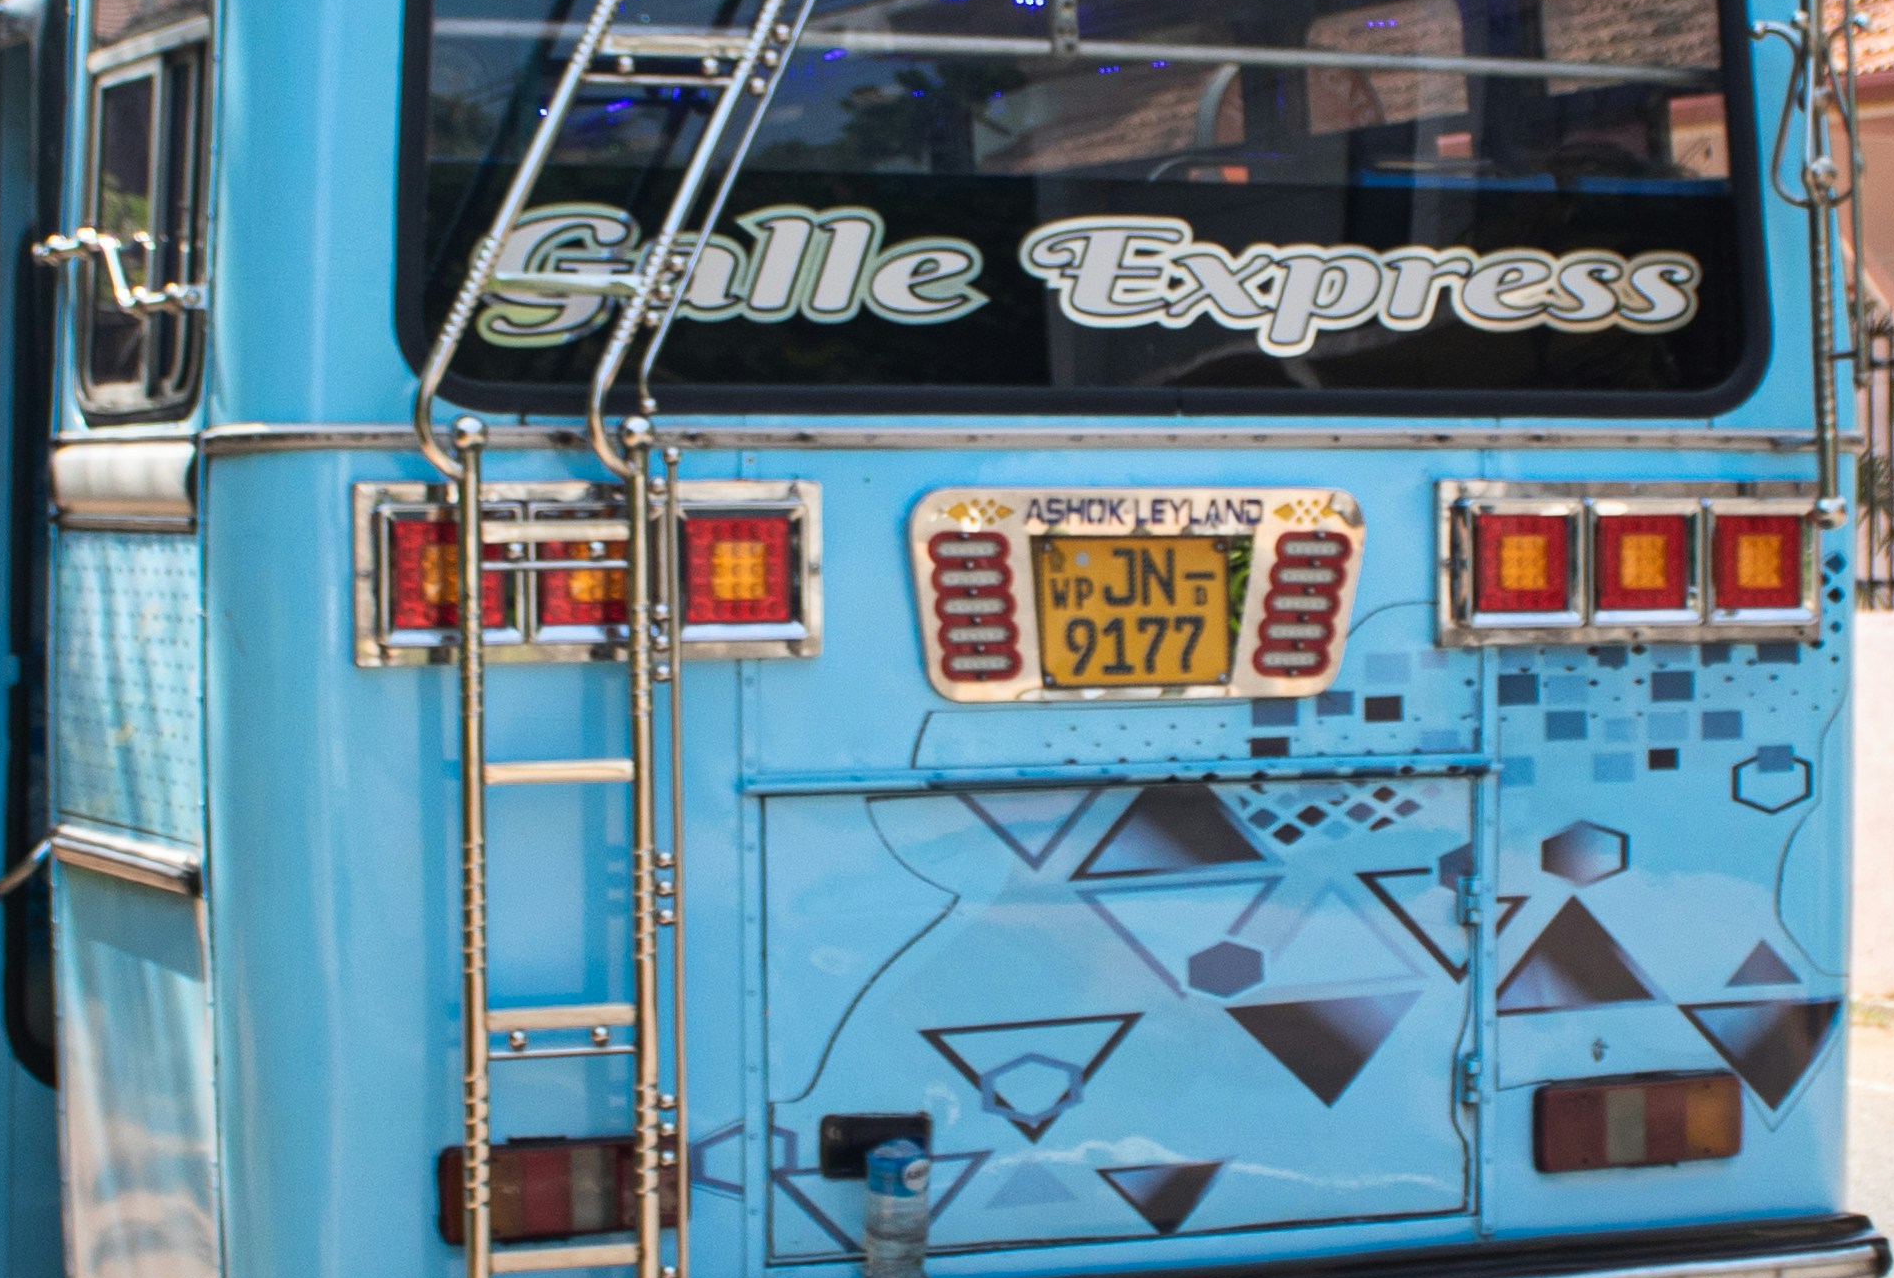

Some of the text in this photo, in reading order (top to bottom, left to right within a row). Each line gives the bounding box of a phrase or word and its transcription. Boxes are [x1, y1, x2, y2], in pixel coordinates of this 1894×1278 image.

[475, 202, 1702, 358] Galle Express
[1023, 497, 1265, 527] ASHOK LEYLAND
[1050, 577, 1094, 610] WP
[1065, 615, 1205, 676] 9177
